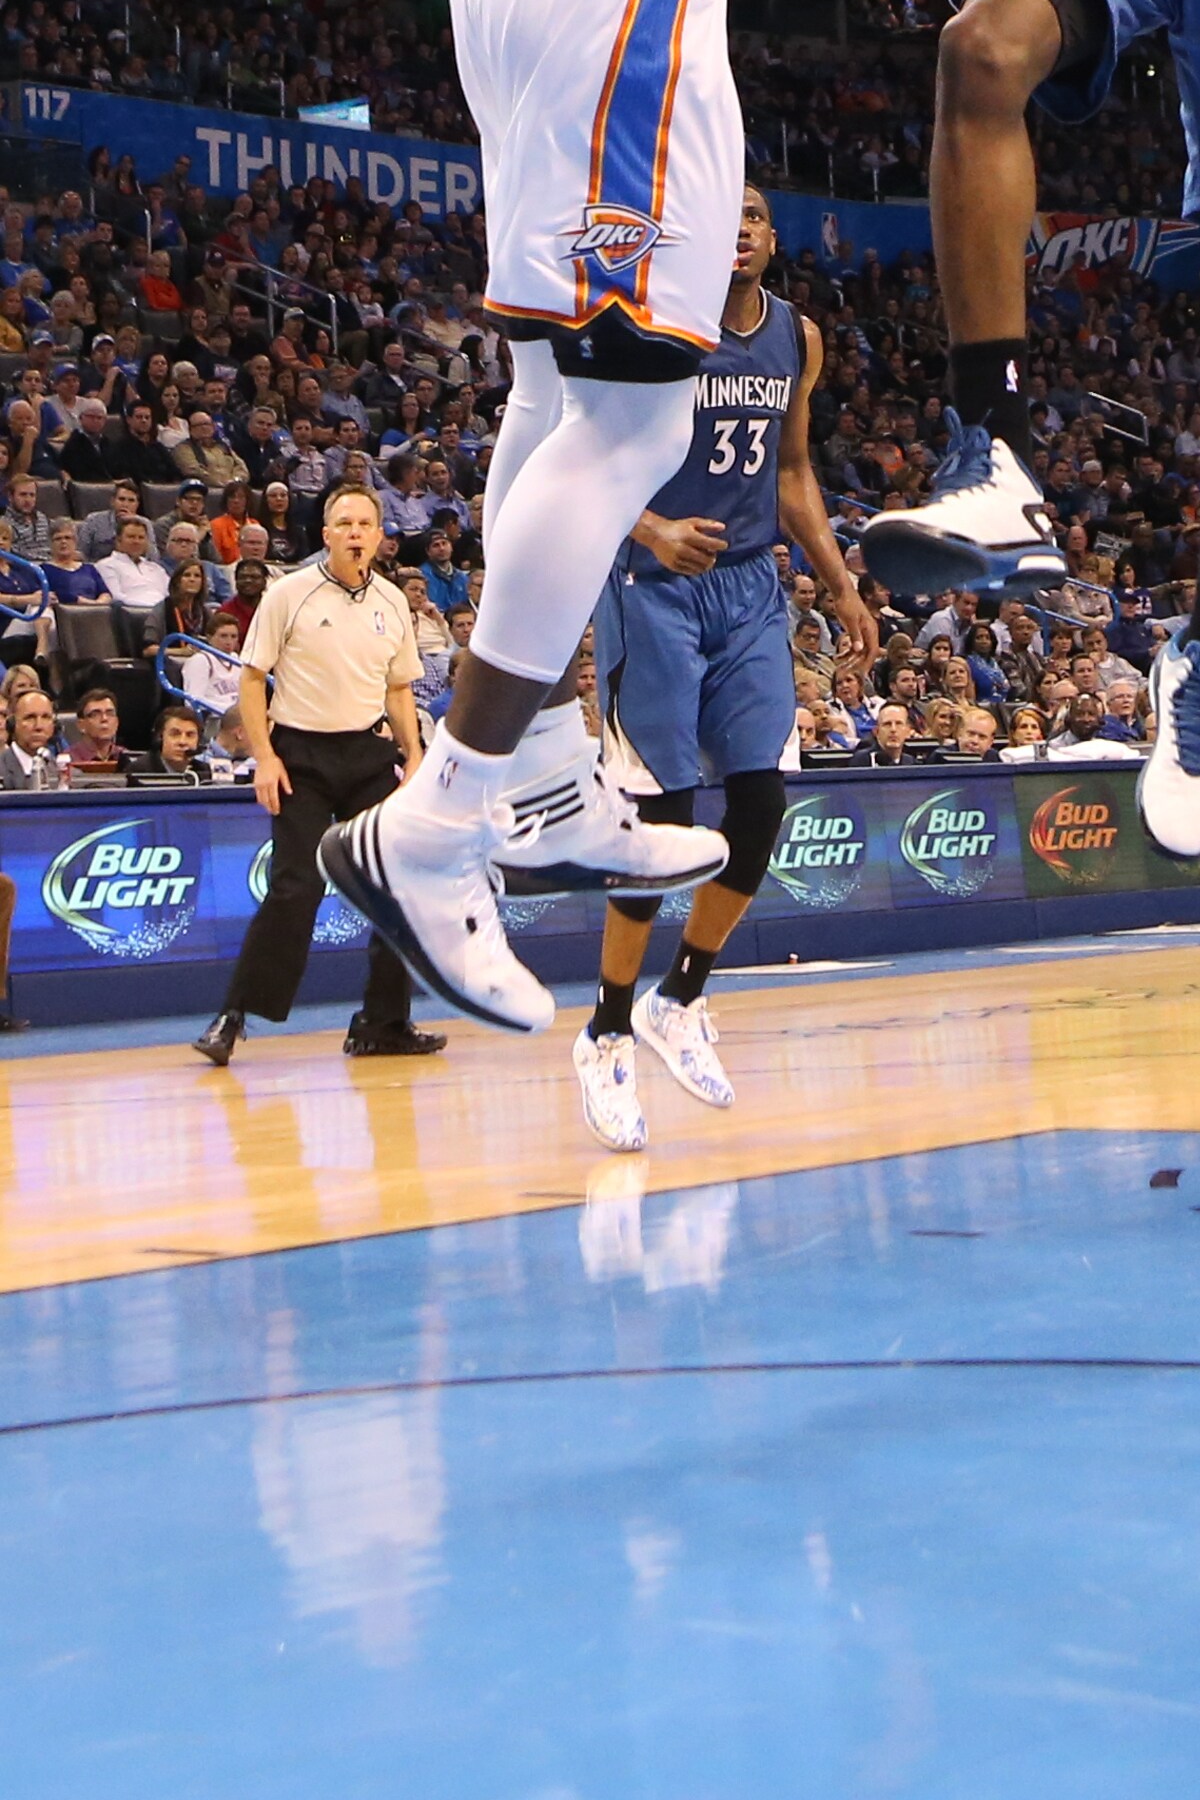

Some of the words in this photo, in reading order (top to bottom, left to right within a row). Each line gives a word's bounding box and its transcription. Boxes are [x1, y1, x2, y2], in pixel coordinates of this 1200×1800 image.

[25, 87, 71, 121] 117
[196, 126, 478, 215] THUNDER
[570, 223, 645, 251] OKC
[694, 373, 792, 412] MINNESOTA
[708, 419, 770, 475] 33
[790, 815, 853, 842] BUD
[927, 808, 985, 834] BUD
[1055, 802, 1109, 827] BUD
[917, 834, 996, 860] LIGHT
[1044, 827, 1118, 851] LIGHT
[87, 844, 183, 877] BUD
[778, 842, 863, 870] LIGHT
[67, 877, 196, 911] LIGHT
